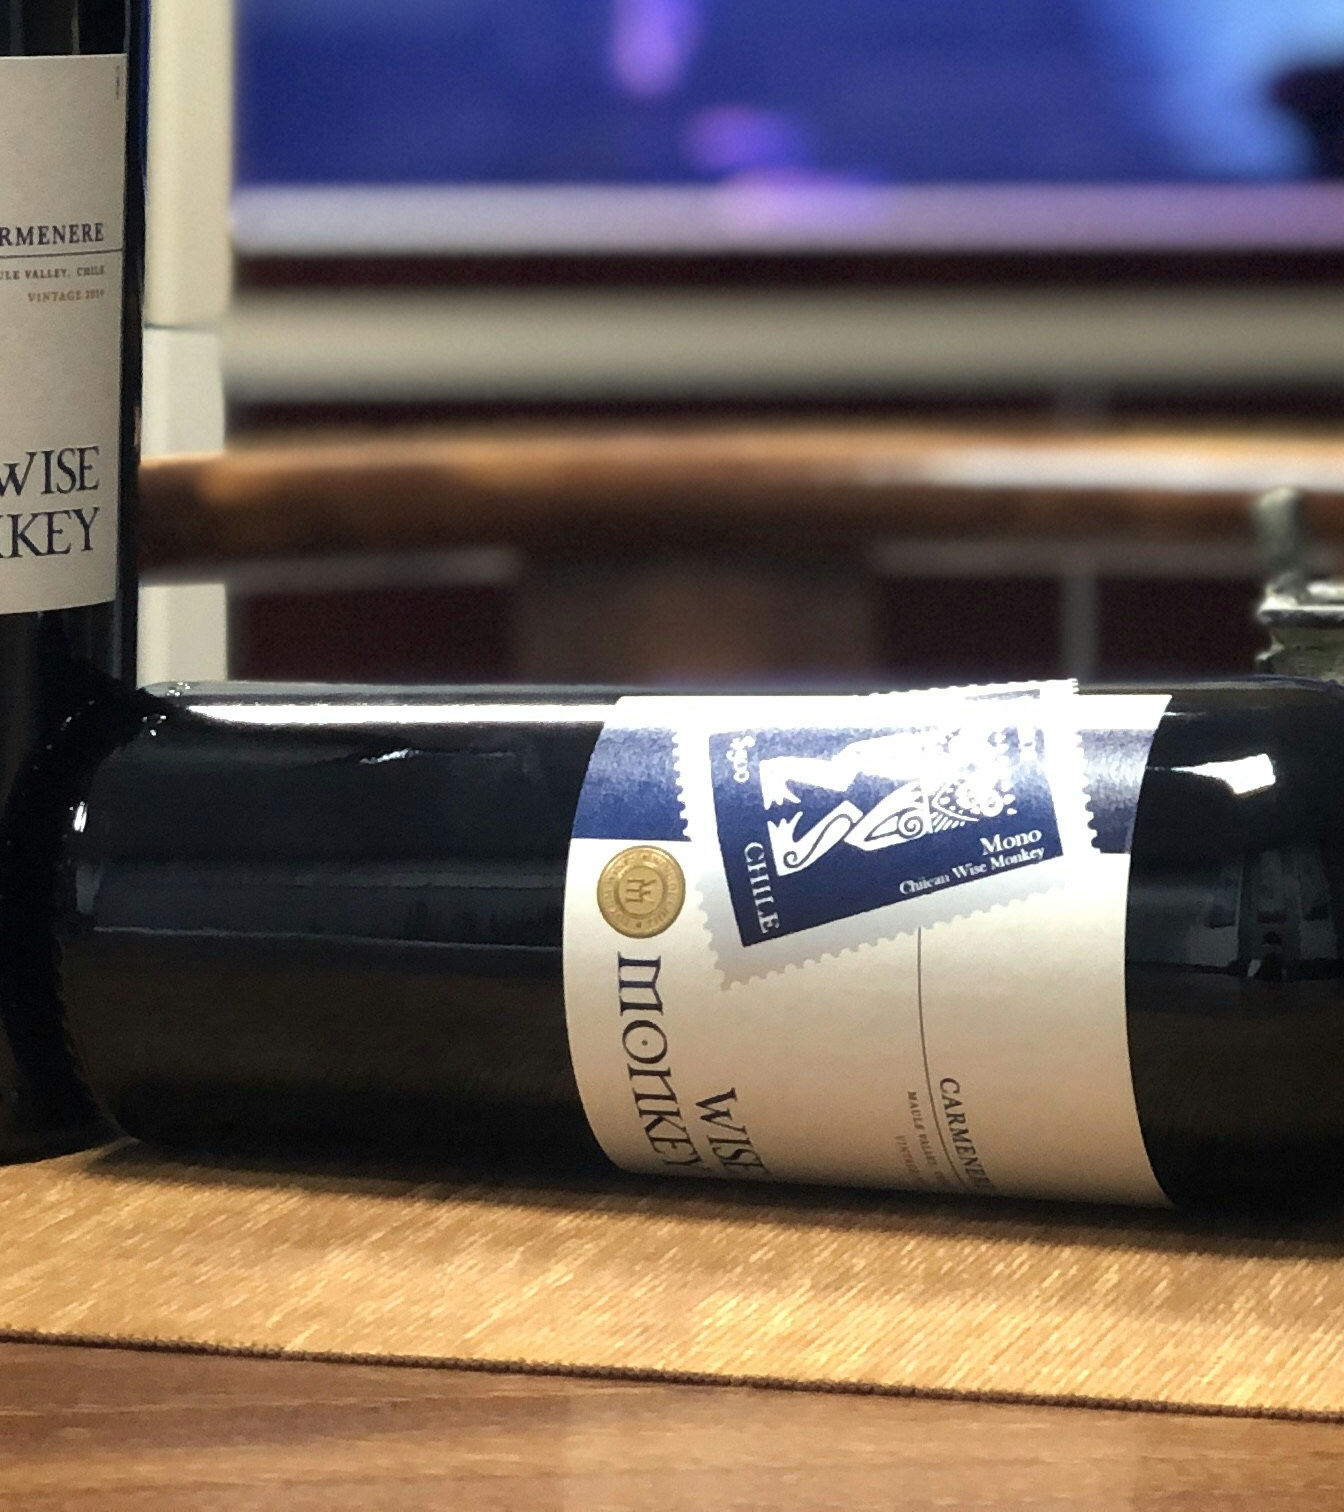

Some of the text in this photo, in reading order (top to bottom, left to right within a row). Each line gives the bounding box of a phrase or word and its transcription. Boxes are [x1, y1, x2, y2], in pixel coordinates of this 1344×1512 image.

[76, 265, 105, 276] CHILE
[27, 290, 82, 303] VINTAGE
[979, 828, 1043, 856] Mono
[990, 847, 1046, 872] Monkey
[743, 841, 781, 934] CHILE
[617, 951, 711, 1172] MONKEY
